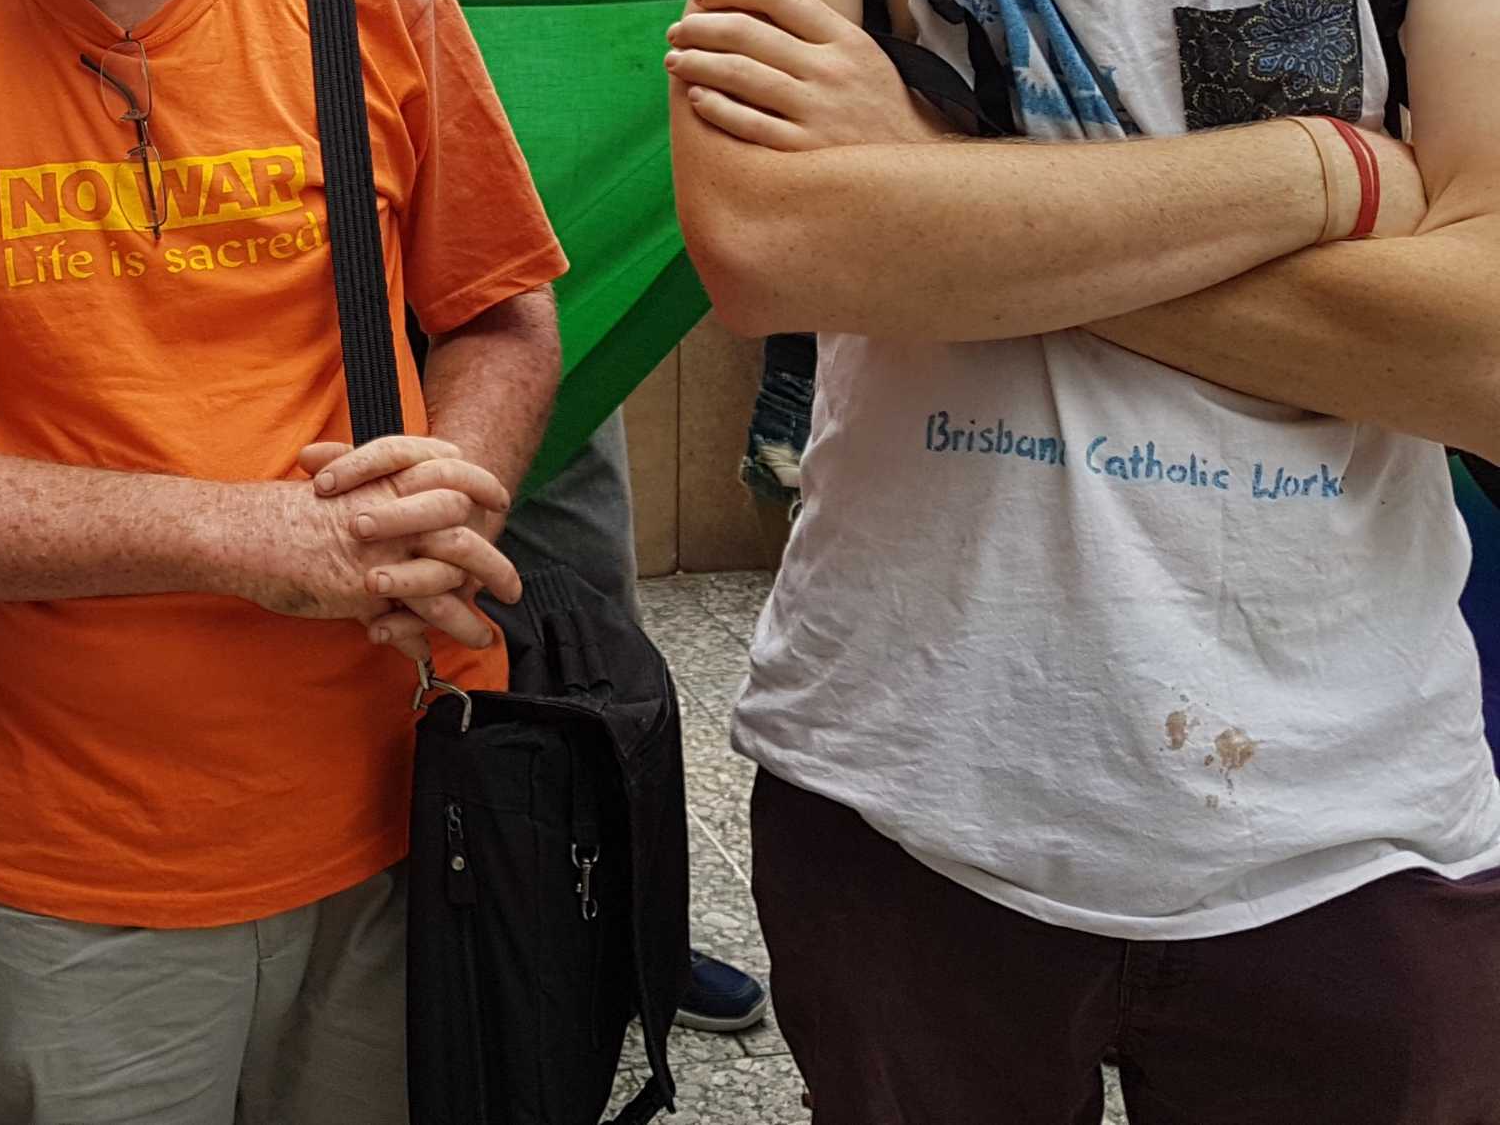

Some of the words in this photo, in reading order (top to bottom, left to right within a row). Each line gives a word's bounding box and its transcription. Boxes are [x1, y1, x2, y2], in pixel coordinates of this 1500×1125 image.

[8, 168, 111, 230] NO
[132, 153, 298, 222] WAR
[3, 239, 96, 288] Life
[109, 241, 147, 277] is
[163, 210, 325, 274] sacred
[1085, 435, 1231, 490] Catholic
